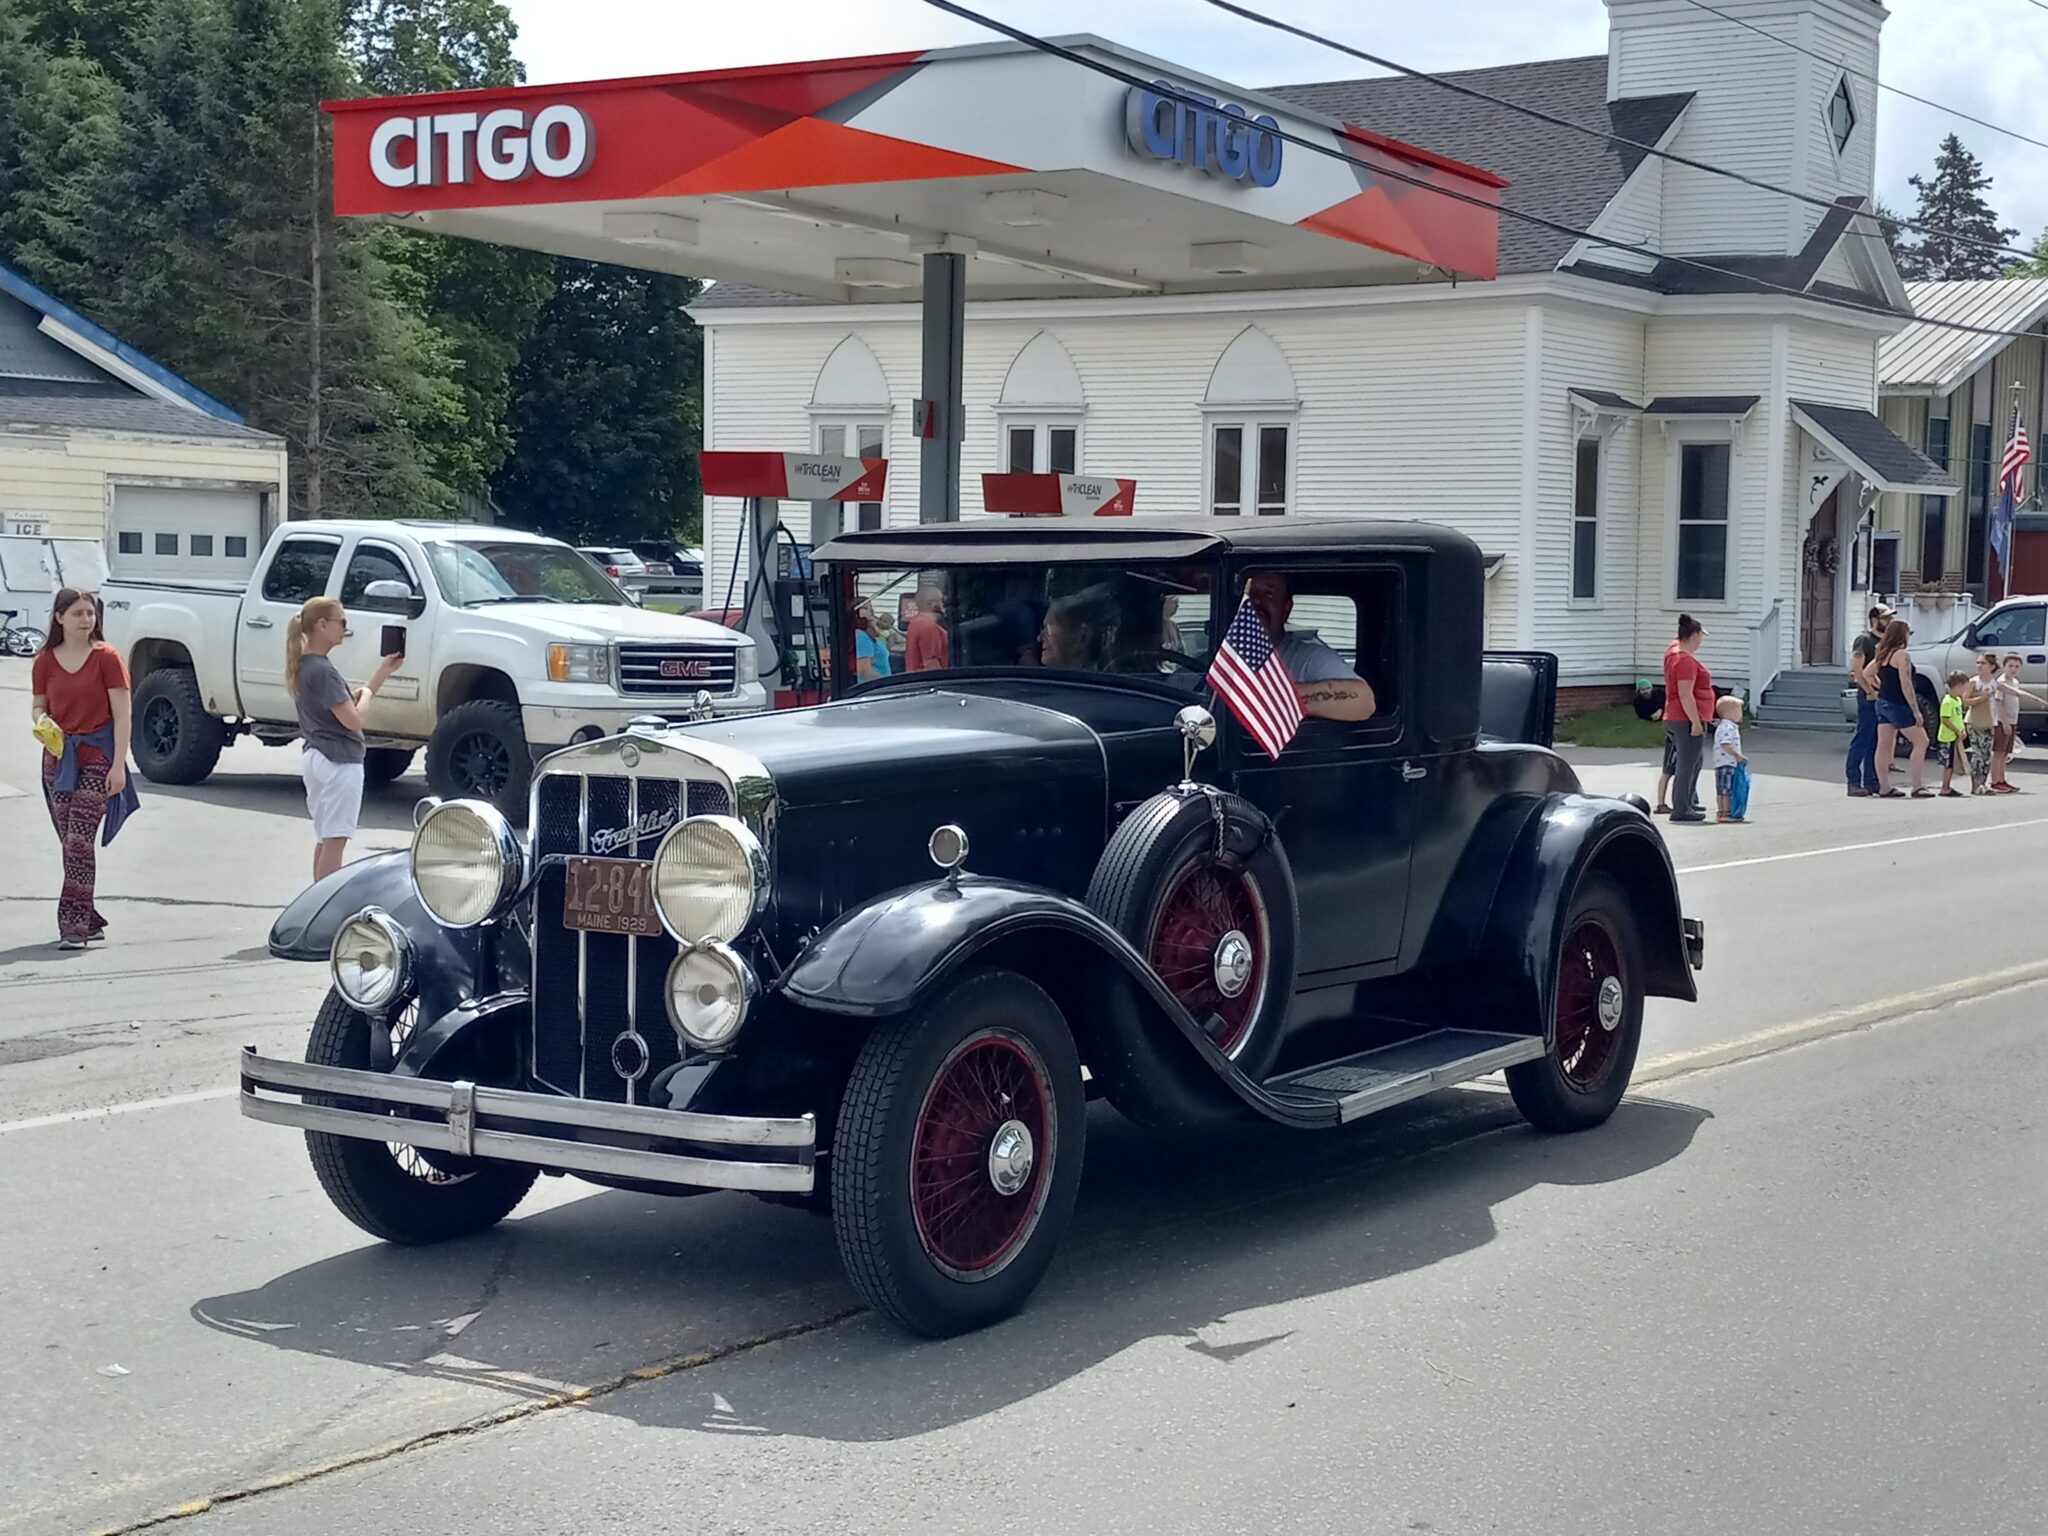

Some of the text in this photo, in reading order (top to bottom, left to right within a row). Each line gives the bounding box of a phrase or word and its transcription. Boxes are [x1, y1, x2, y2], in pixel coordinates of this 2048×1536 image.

[369, 104, 589, 188] CITGO
[1136, 80, 1282, 188] CITGO
[16, 524, 42, 535] ICE
[660, 660, 711, 677] GMC
[590, 807, 675, 854] Franklin
[577, 913, 647, 932] MAINE 1929
